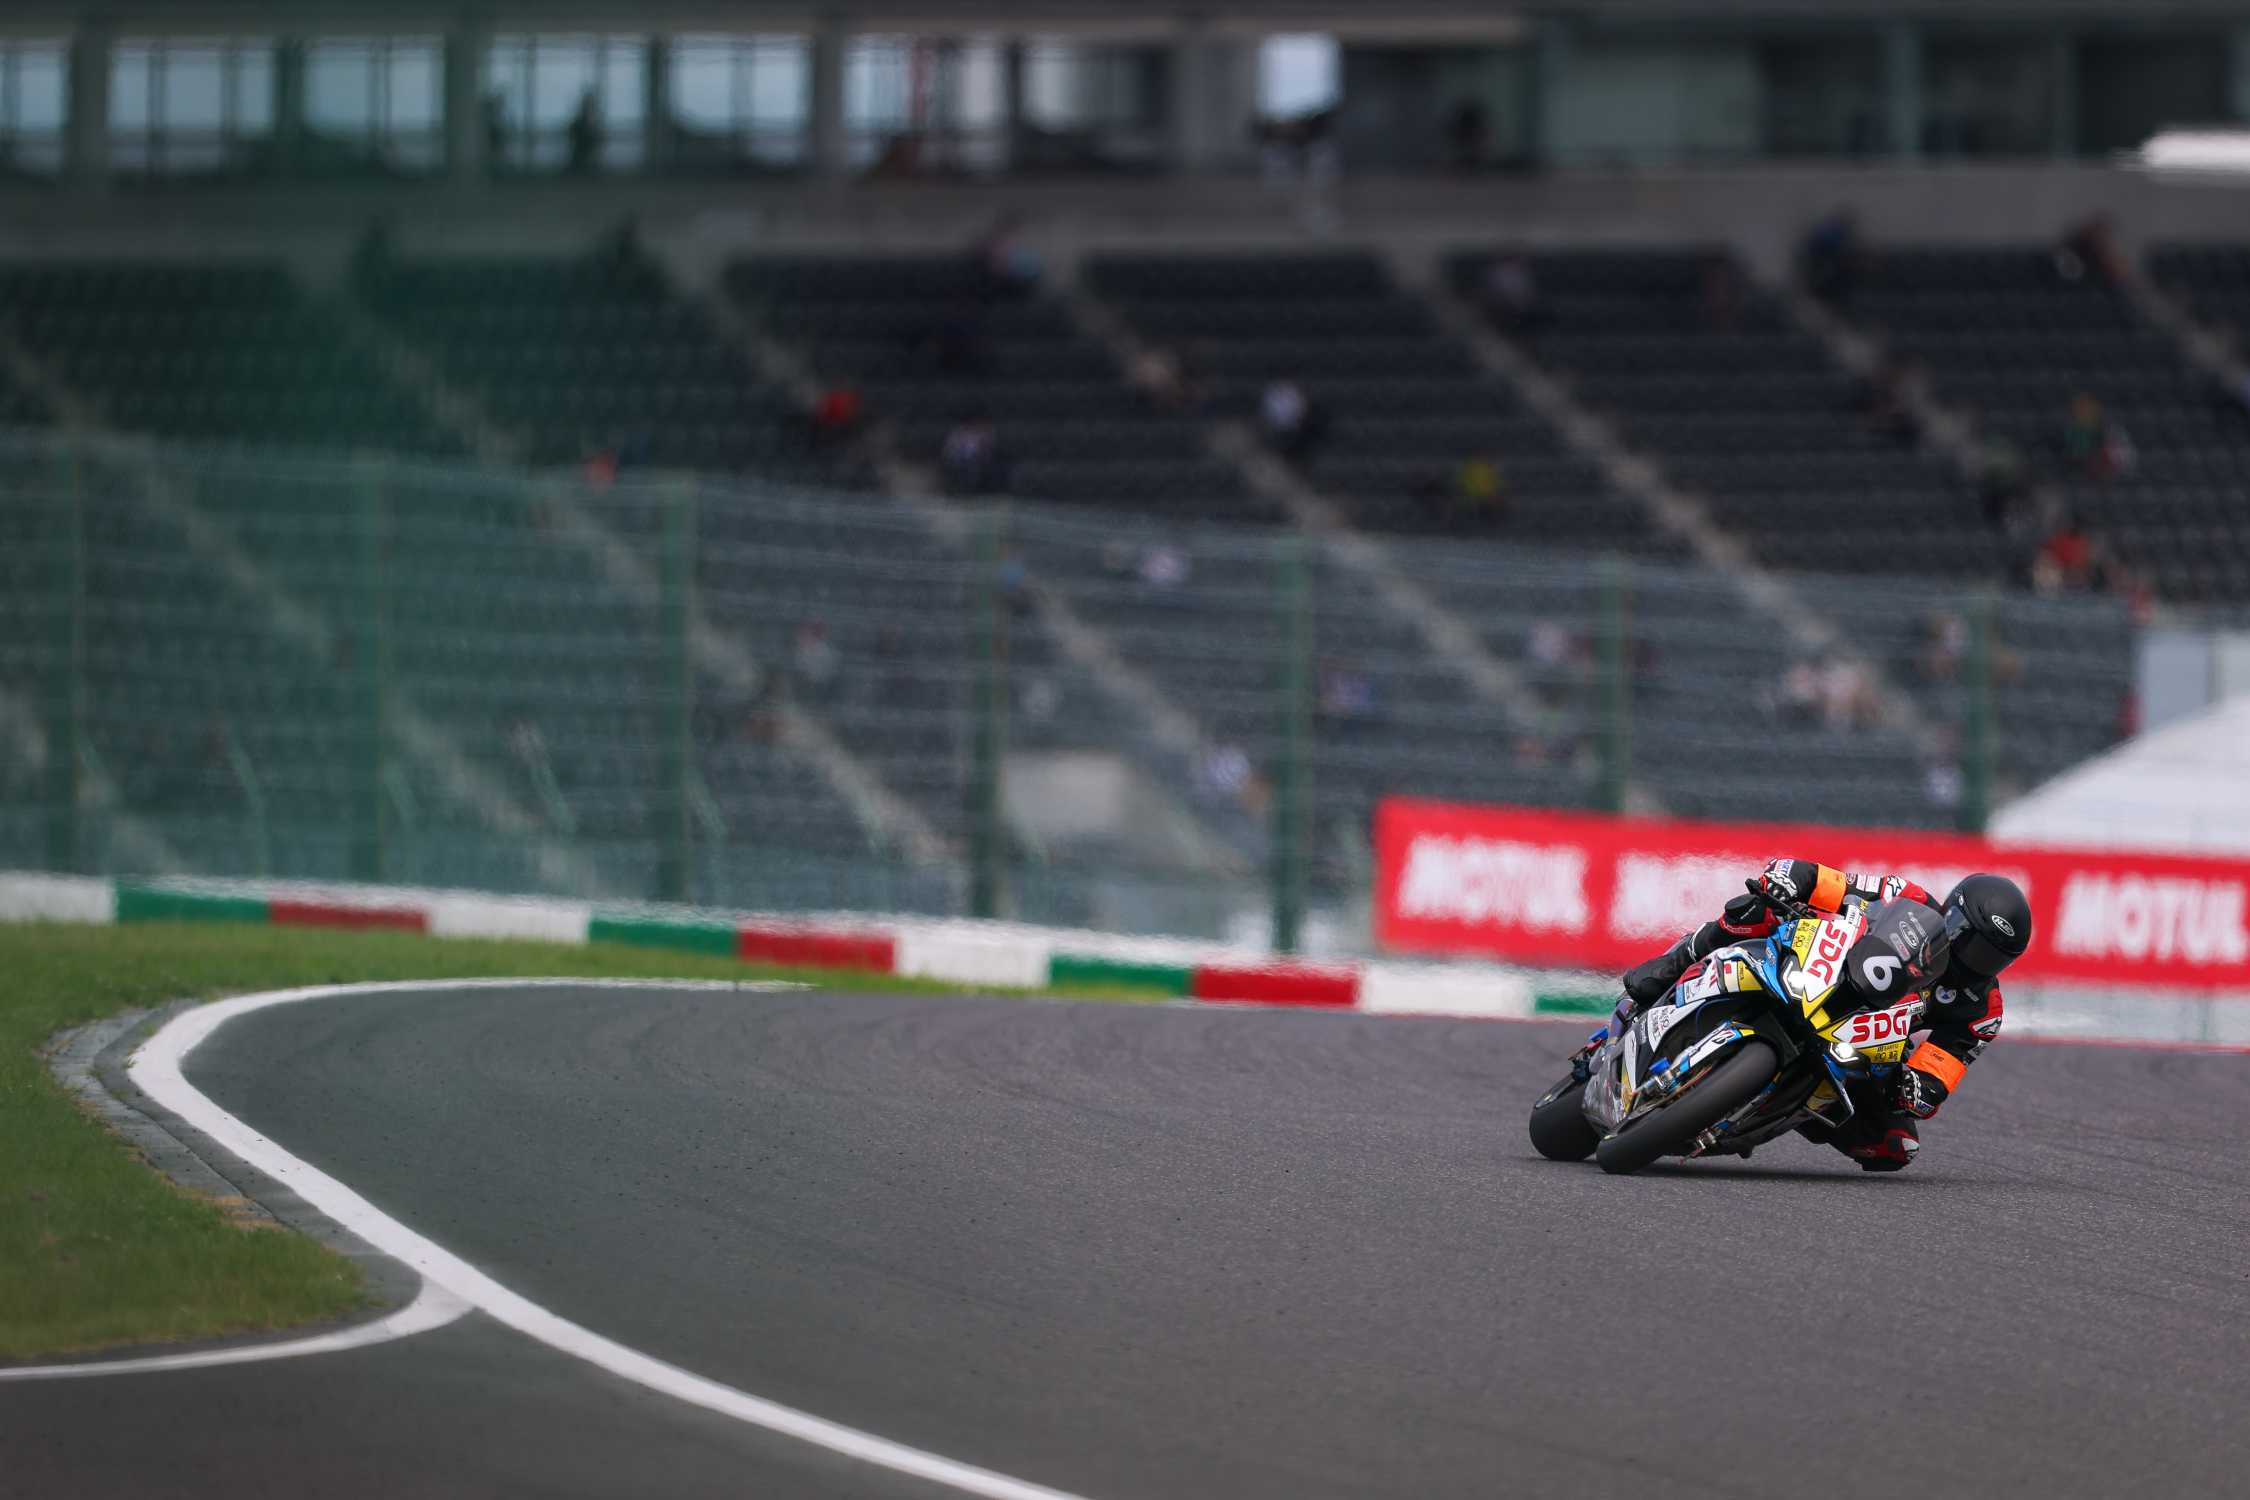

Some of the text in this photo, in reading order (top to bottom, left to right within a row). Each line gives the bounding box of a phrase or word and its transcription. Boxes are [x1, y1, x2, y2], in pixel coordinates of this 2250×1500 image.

[2053, 870, 2248, 965] MOTUL
[1807, 920, 1848, 987] SDG
[1862, 955, 1902, 992] 6
[1850, 1008, 1909, 1044] SDG
